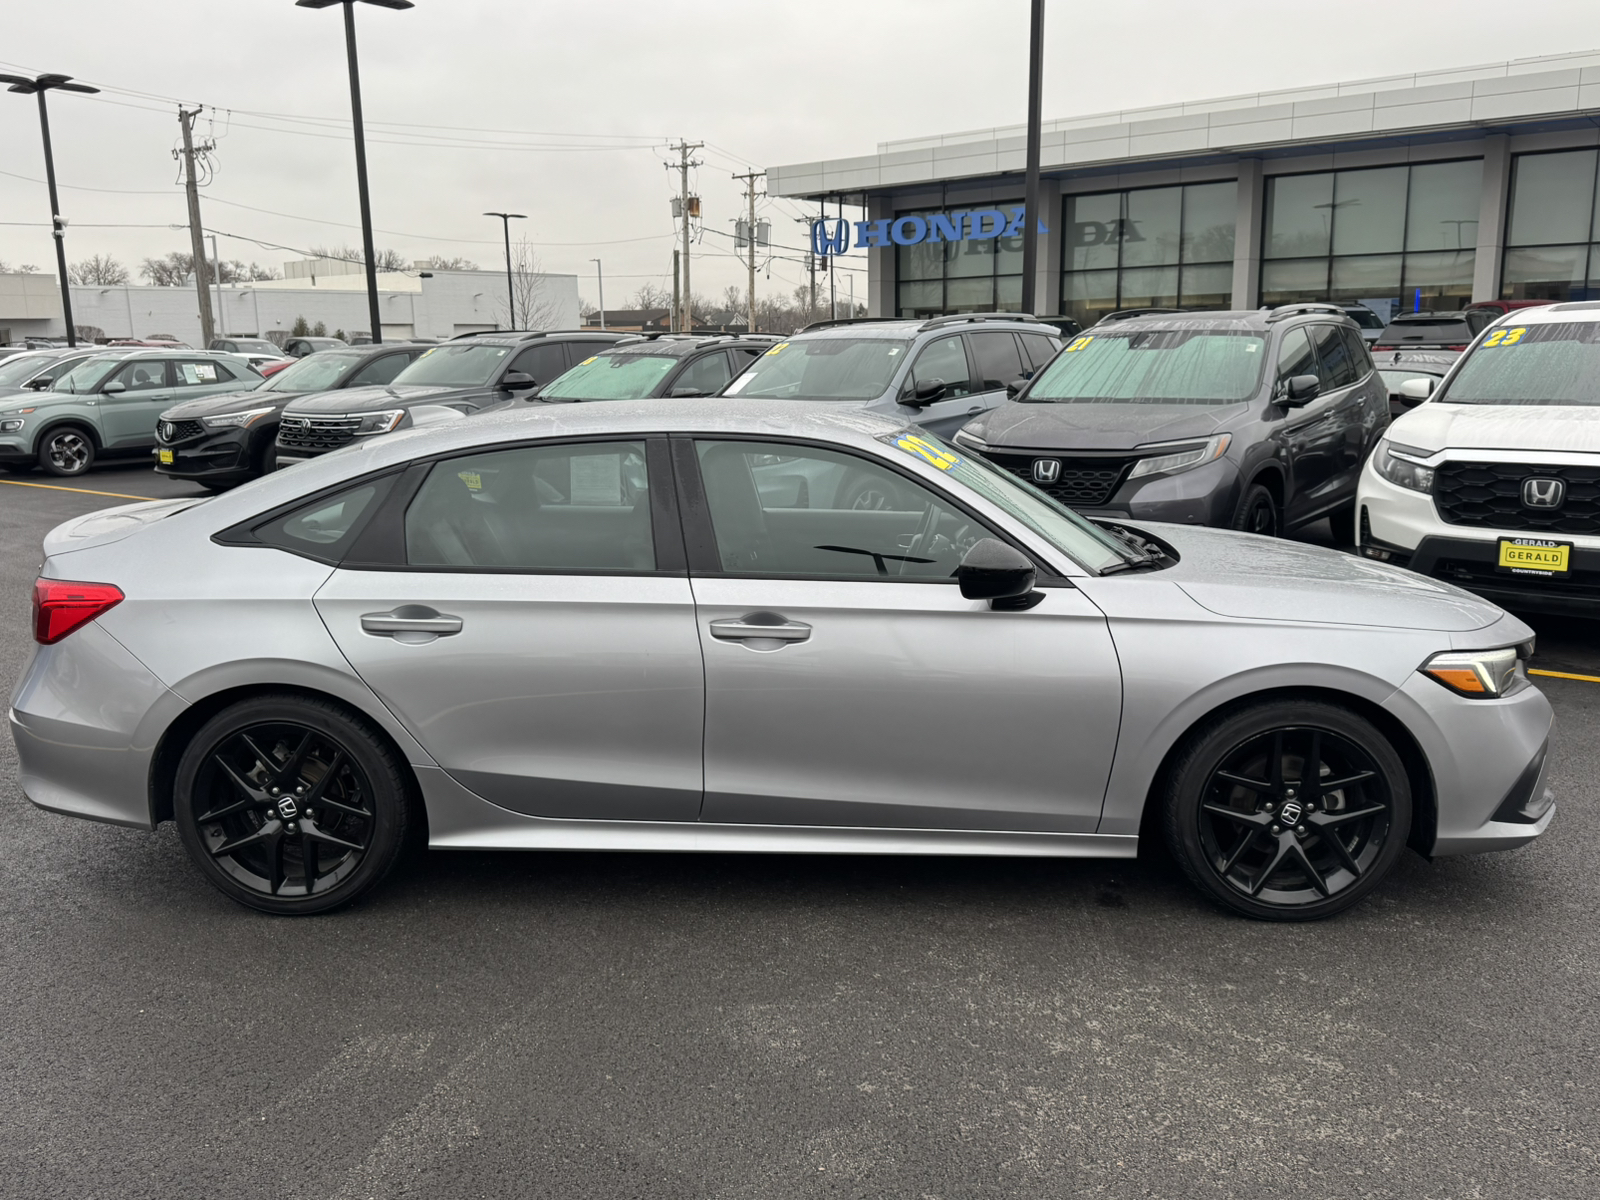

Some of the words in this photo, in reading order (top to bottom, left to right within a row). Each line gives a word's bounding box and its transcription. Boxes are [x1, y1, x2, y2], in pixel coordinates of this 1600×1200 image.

[854, 207, 1049, 249] HONDA
[1064, 335, 1096, 353] 21
[1481, 326, 1529, 350] 23
[894, 433, 961, 472] 22
[1514, 538, 1557, 548] GERALD
[1508, 550, 1559, 563] GERALD
